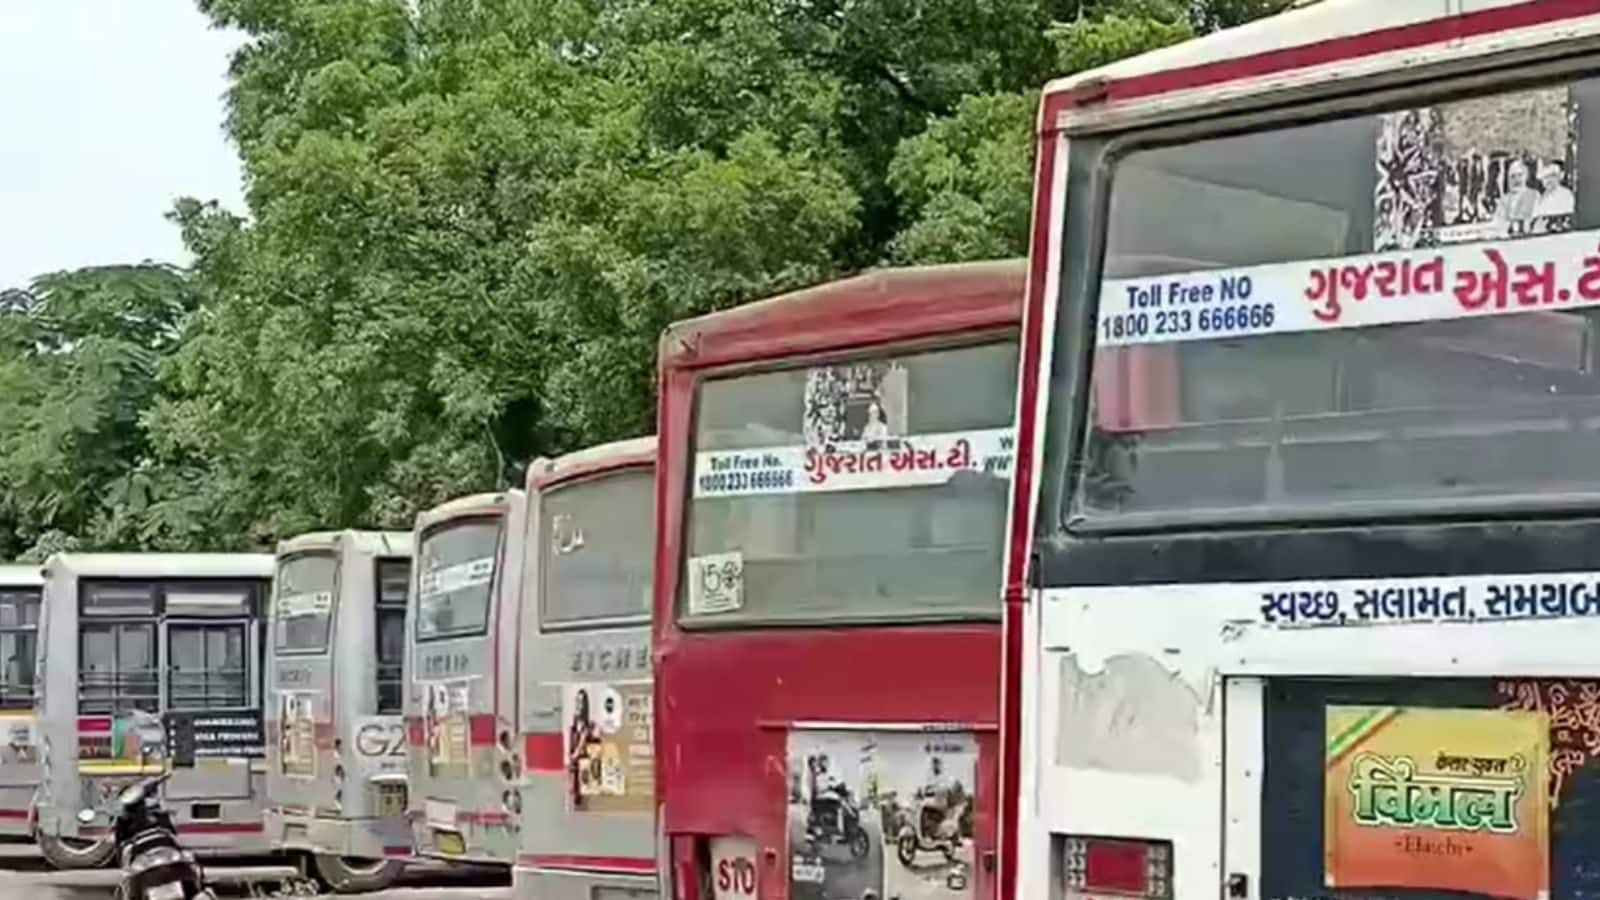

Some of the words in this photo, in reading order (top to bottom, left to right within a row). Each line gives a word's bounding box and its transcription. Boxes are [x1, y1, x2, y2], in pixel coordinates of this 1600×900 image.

[1126, 285, 1161, 309] Toll
[1168, 282, 1214, 305] Free
[1220, 276, 1253, 302] NO
[1304, 255, 1445, 322] ગુજરાત
[1453, 243, 1600, 309] એસ.ટ
[1102, 313, 1149, 340] 1800
[1155, 310, 1192, 335] 233
[1198, 304, 1276, 331] 666666
[710, 457, 731, 472] Toll
[734, 455, 760, 470] Free
[804, 446, 883, 484] ગુજરાત
[1260, 590, 1347, 625] સ્વચ્છ,
[1353, 586, 1476, 622] સલામત,
[1484, 583, 1600, 616] સમયબ
[571, 645, 649, 673] EICHE
[356, 724, 407, 757] G2
[1350, 753, 1524, 831] विमल
[718, 857, 756, 895] STO
